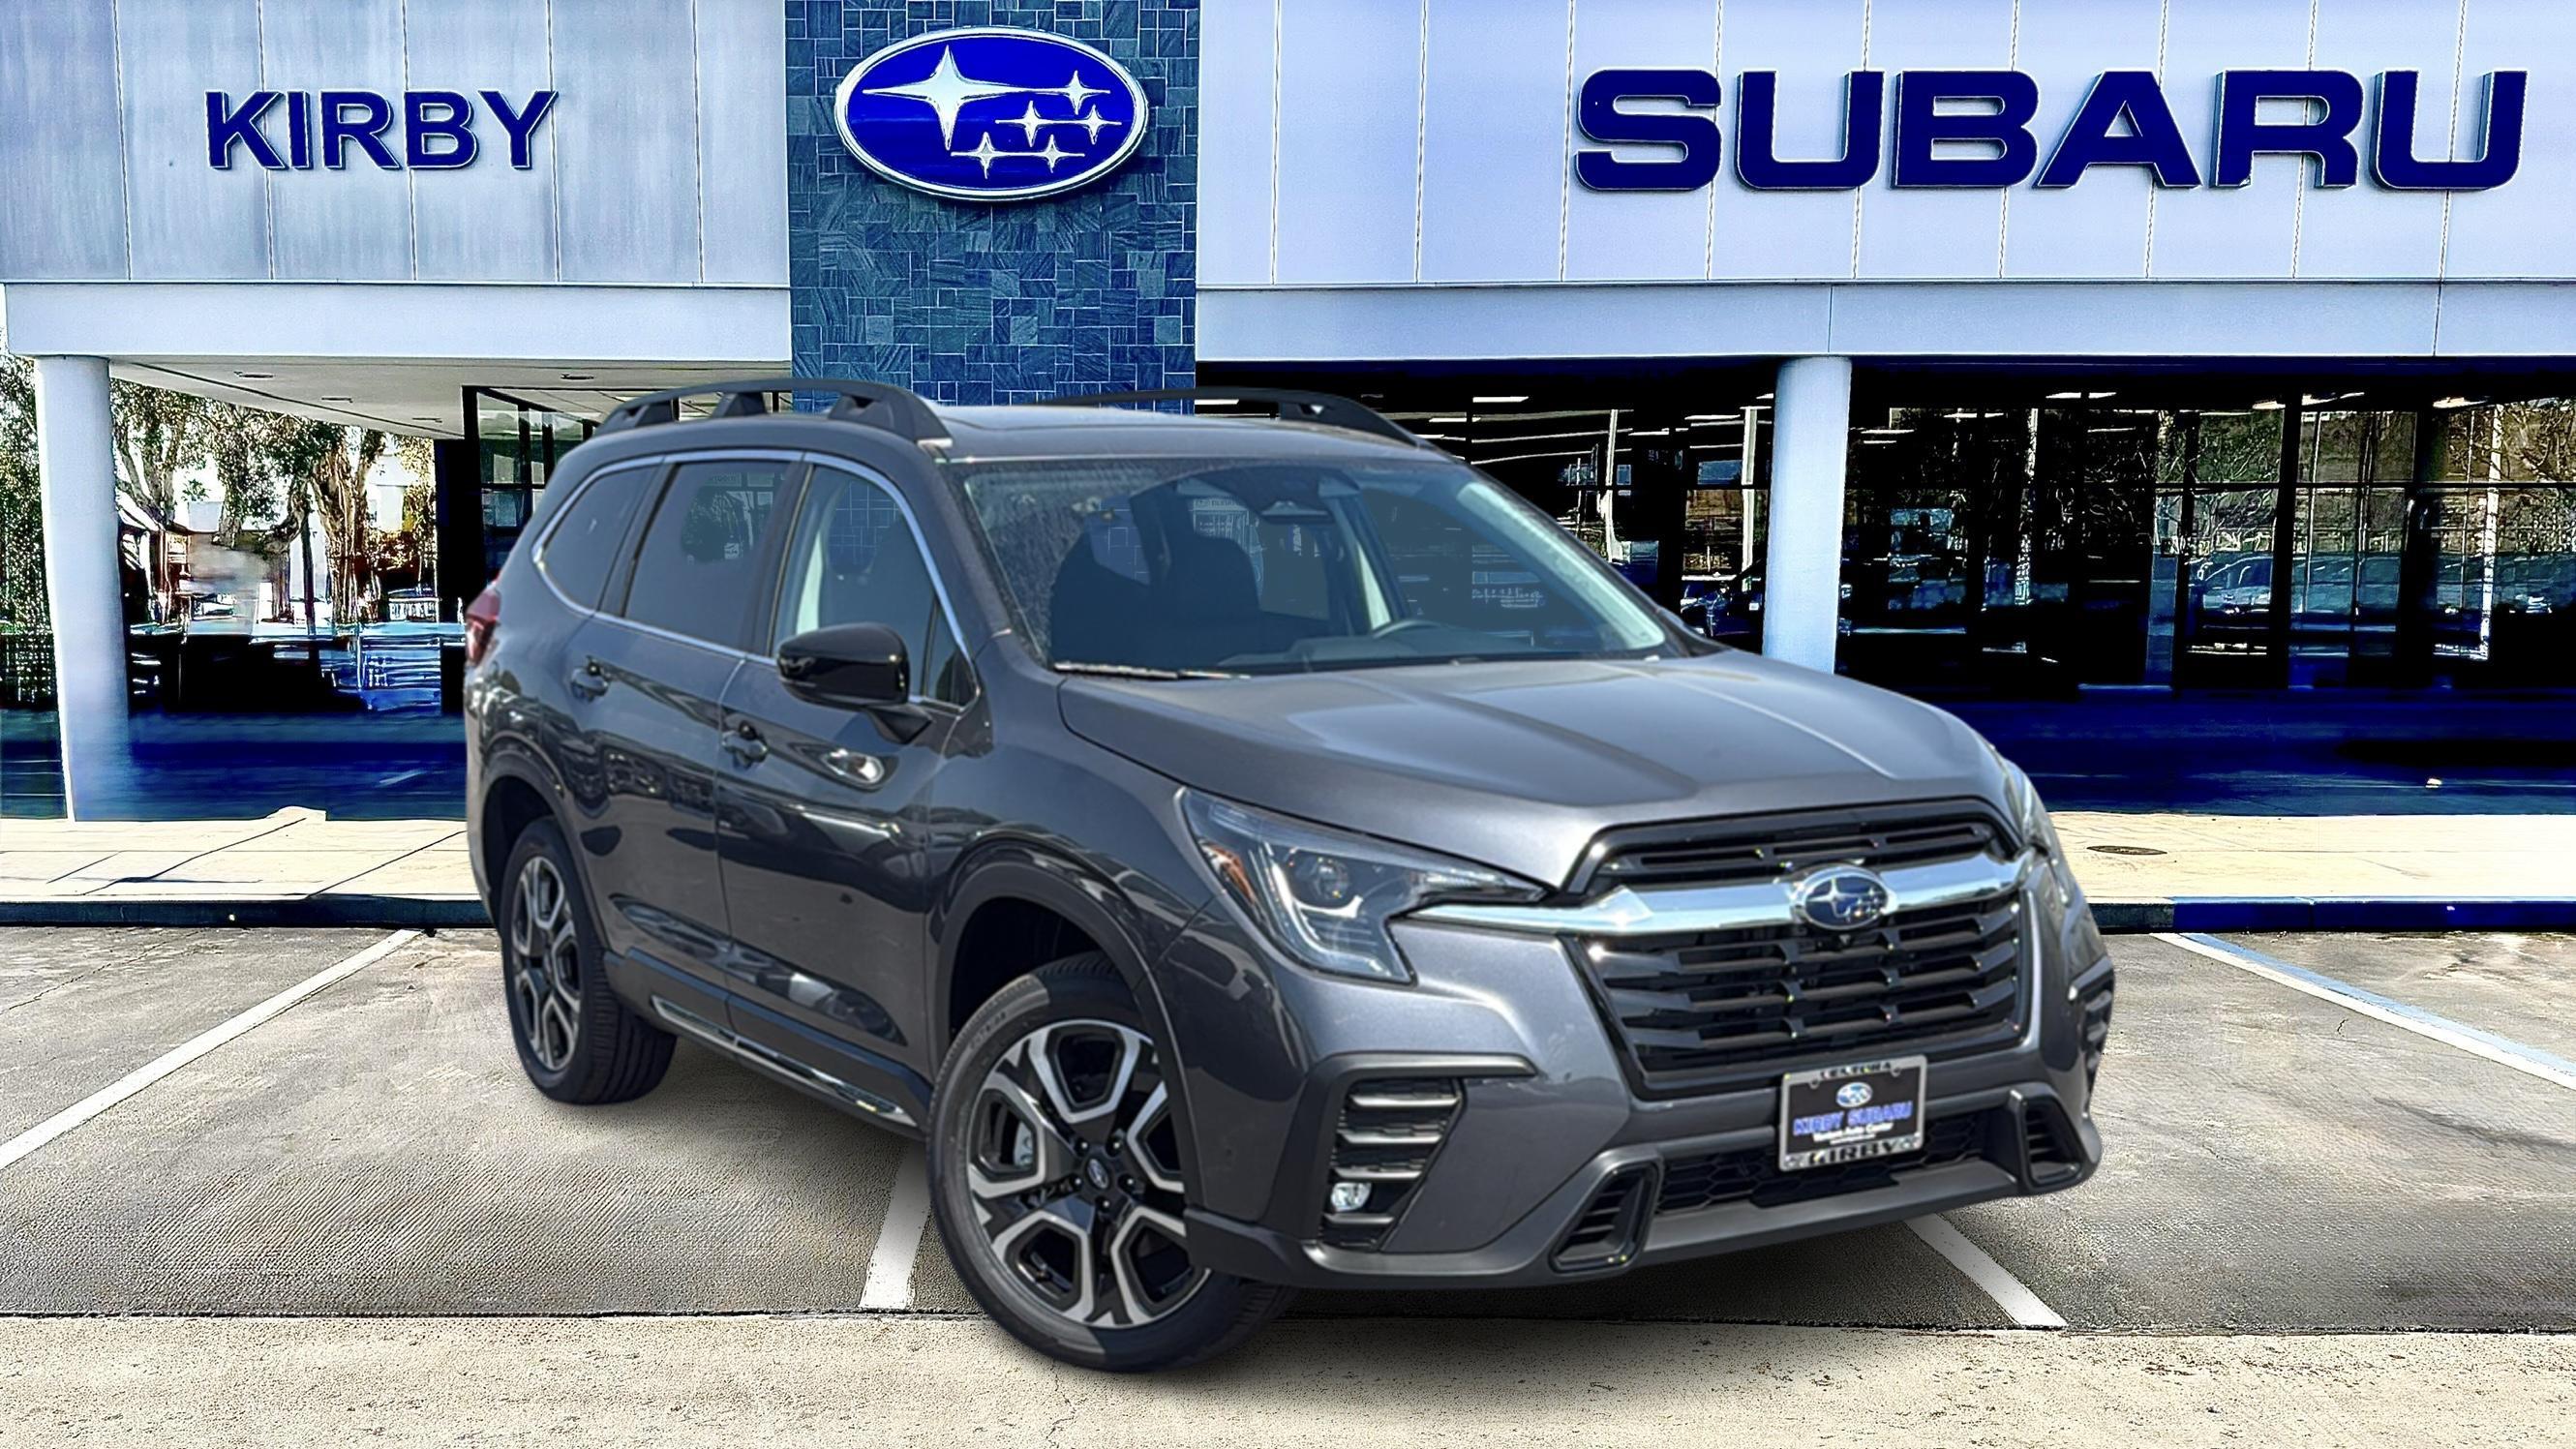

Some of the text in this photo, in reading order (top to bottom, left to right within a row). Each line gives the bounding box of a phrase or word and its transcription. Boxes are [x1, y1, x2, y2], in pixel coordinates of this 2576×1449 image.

[204, 90, 560, 170] KIRBY
[1575, 69, 2530, 191] SUBARU
[1847, 1101, 1913, 1126] SUBARU
[1808, 1142, 1898, 1164] KIRBY
